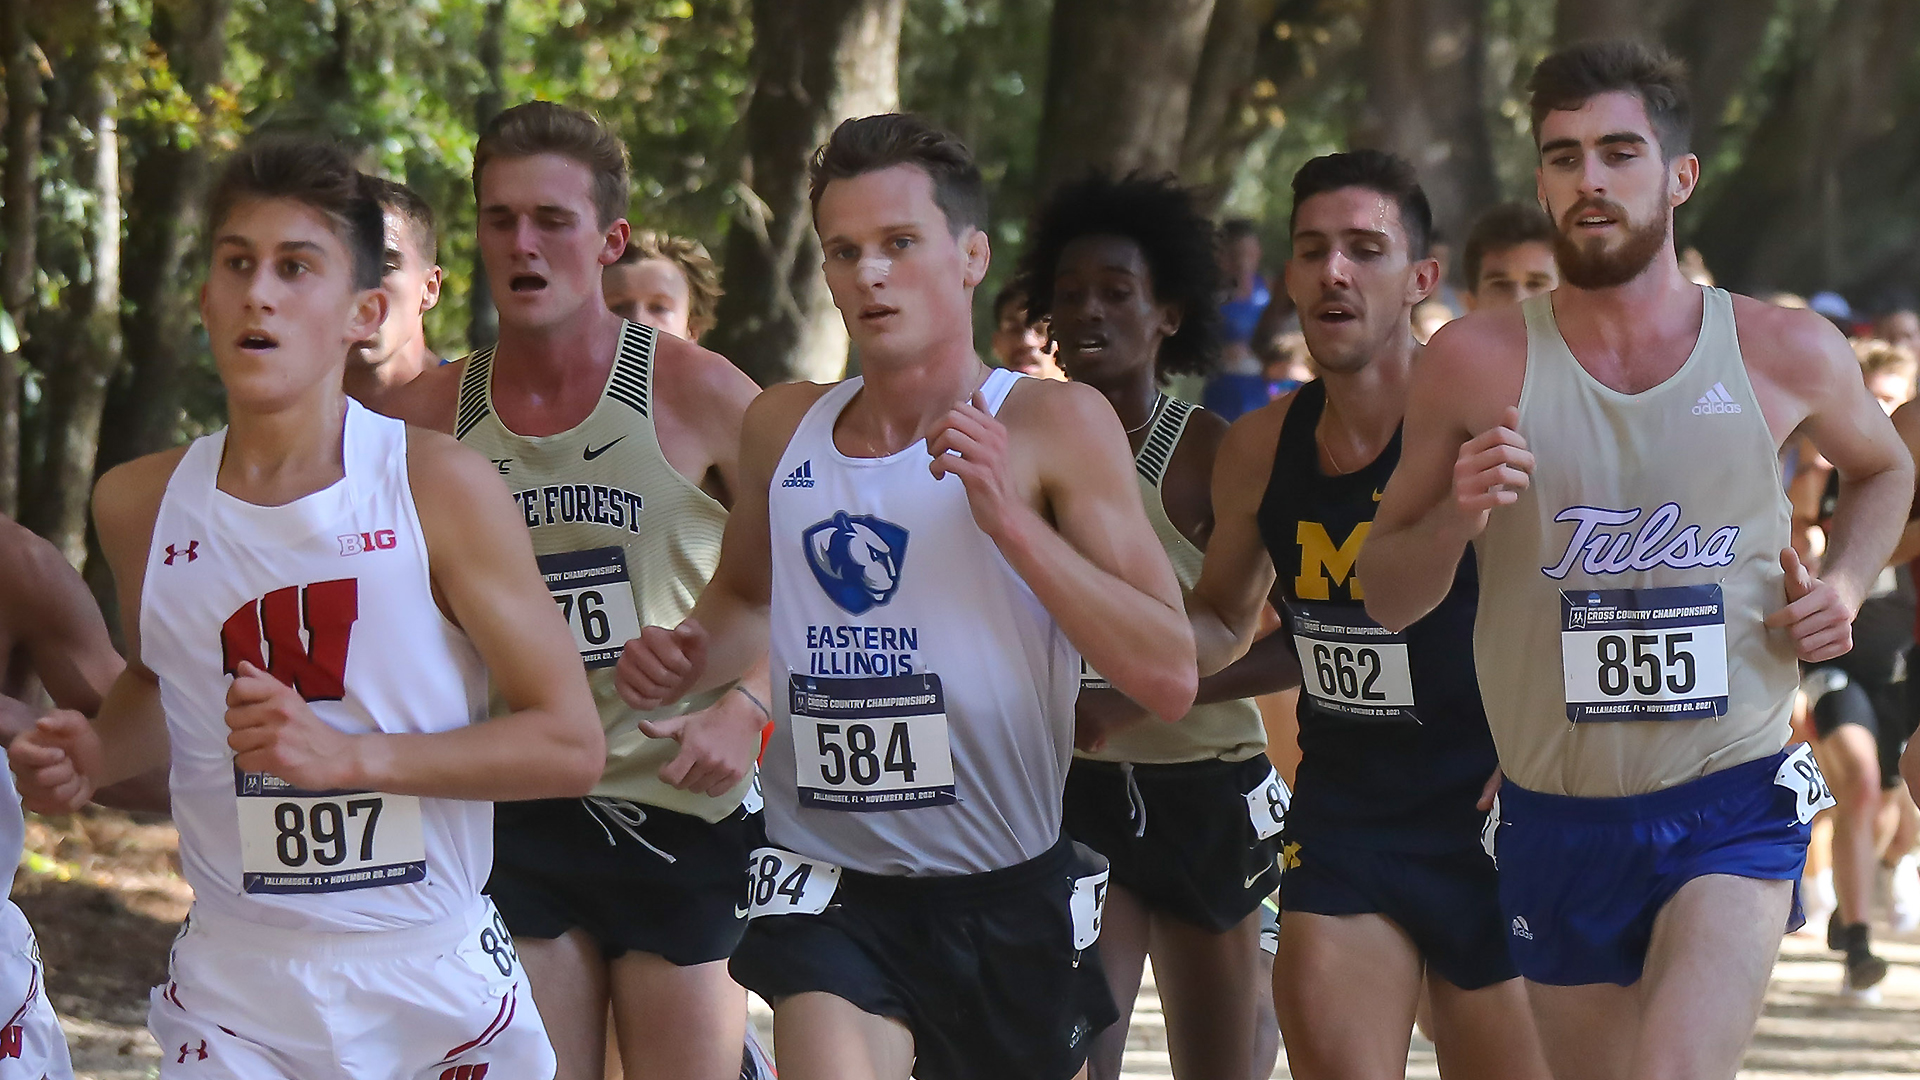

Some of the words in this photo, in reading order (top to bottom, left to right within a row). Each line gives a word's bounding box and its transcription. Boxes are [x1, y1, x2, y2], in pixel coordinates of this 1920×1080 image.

[1691, 402, 1742, 415] adidas
[782, 477, 815, 488] adidas
[542, 484, 644, 535] FOREST
[1541, 501, 1741, 580] Tulsa
[563, 564, 622, 580] CHAMPIONSHIPS
[1295, 520, 1373, 600] M
[1588, 610, 1615, 621] CROSS
[1616, 609, 1651, 620] COUNTRY
[1652, 605, 1718, 620] CHAMPIONSHIPS
[220, 577, 358, 703] W
[807, 625, 918, 650] EASTERN
[810, 652, 913, 677] ILLINOIS
[1313, 643, 1386, 701] 662
[1597, 632, 1696, 696] 855
[830, 699, 865, 709] COUNTRY
[866, 694, 936, 708] CHAMPIONSHIPS
[1646, 703, 1681, 713] NOVEMBER
[1695, 701, 1711, 711] 2021
[816, 721, 917, 786] 584
[274, 798, 383, 867] 897
